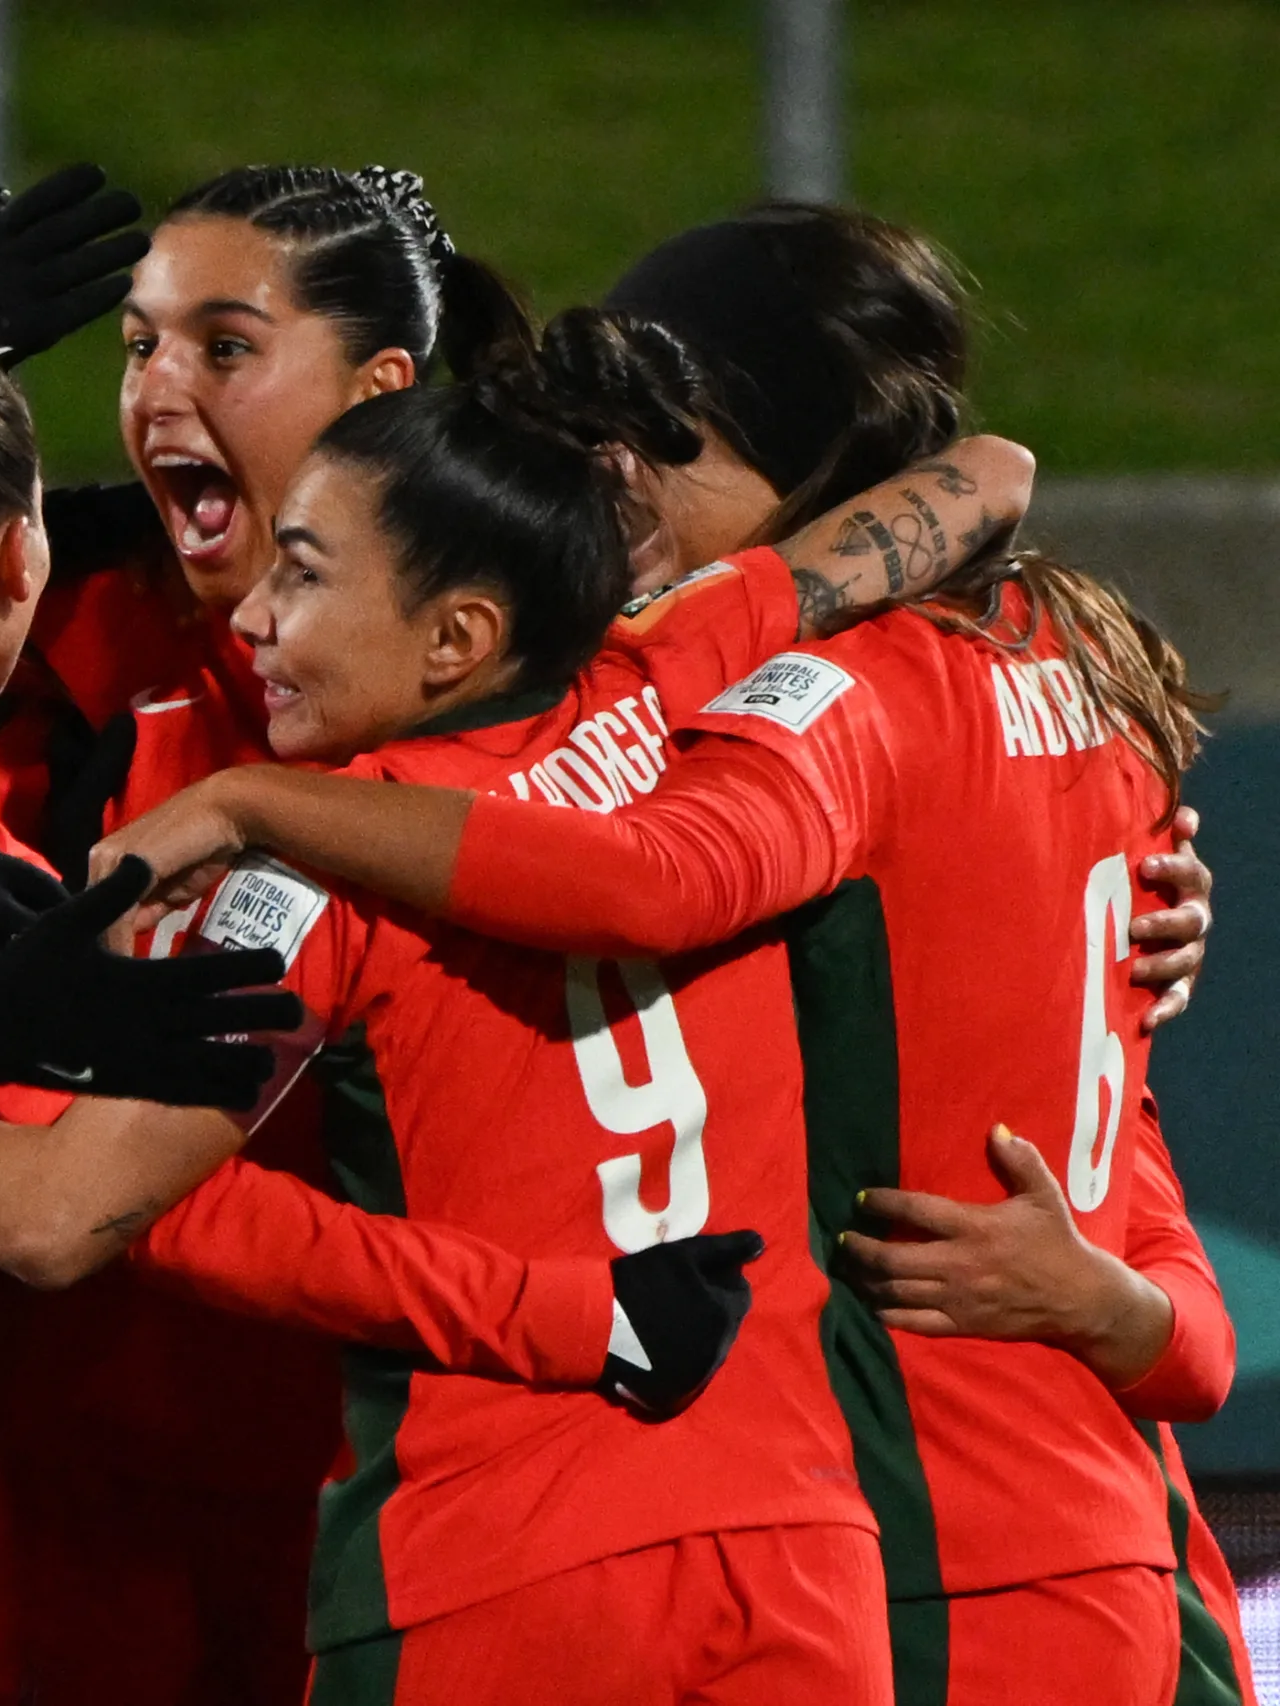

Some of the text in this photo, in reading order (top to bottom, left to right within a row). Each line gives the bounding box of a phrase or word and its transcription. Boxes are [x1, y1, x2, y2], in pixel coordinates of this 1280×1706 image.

[752, 671, 815, 690] UNITES
[764, 663, 820, 680] FOOTBALL
[230, 888, 288, 932] UNITES
[240, 873, 295, 912] FOOTBALL
[218, 910, 235, 930] the
[235, 920, 281, 949] World
[1067, 852, 1132, 1213] 6
[566, 951, 710, 1255] 9
